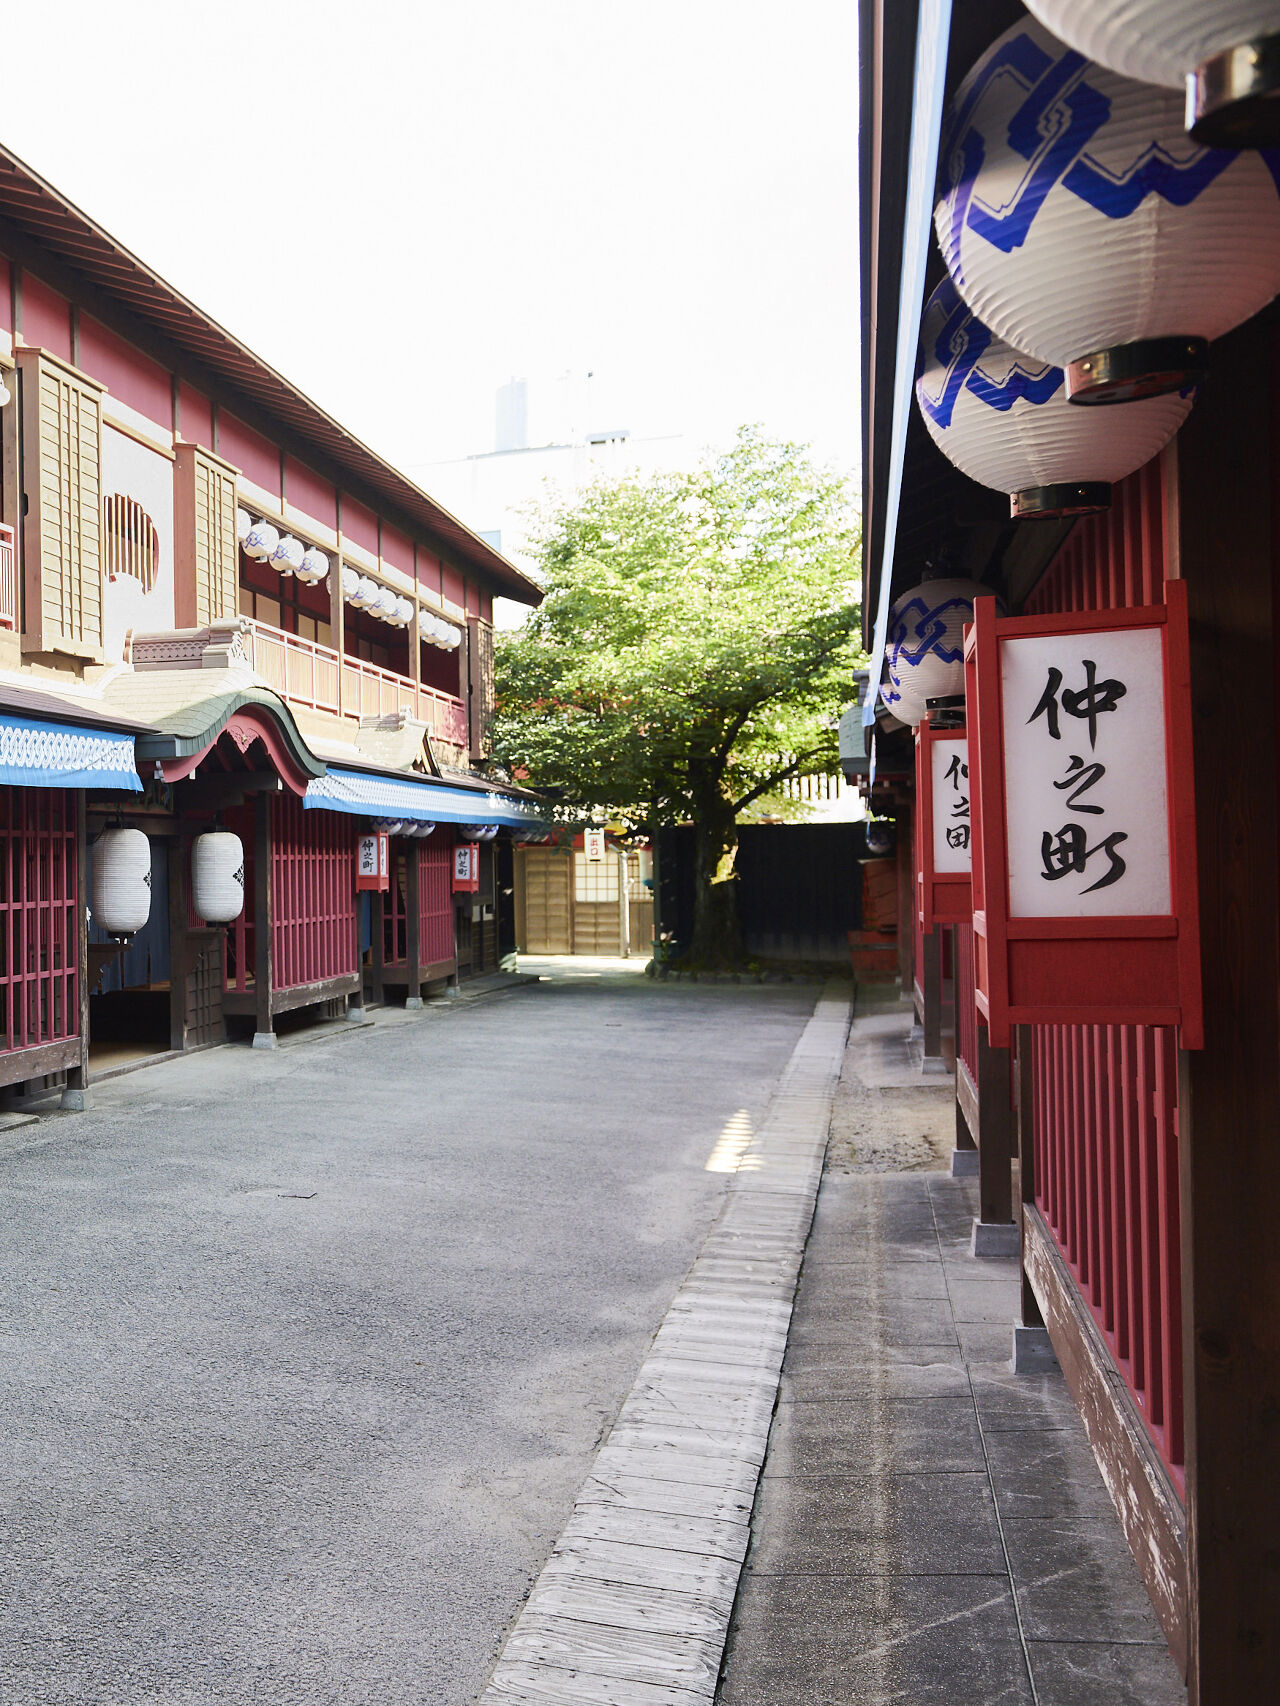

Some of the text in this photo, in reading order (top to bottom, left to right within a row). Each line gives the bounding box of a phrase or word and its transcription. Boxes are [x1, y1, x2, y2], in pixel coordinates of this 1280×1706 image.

[1025, 659, 1128, 895] 仲之町
[362, 839, 374, 873] 仲之町
[590, 837, 599, 856] 出口
[457, 849, 468, 876] 仲之町
